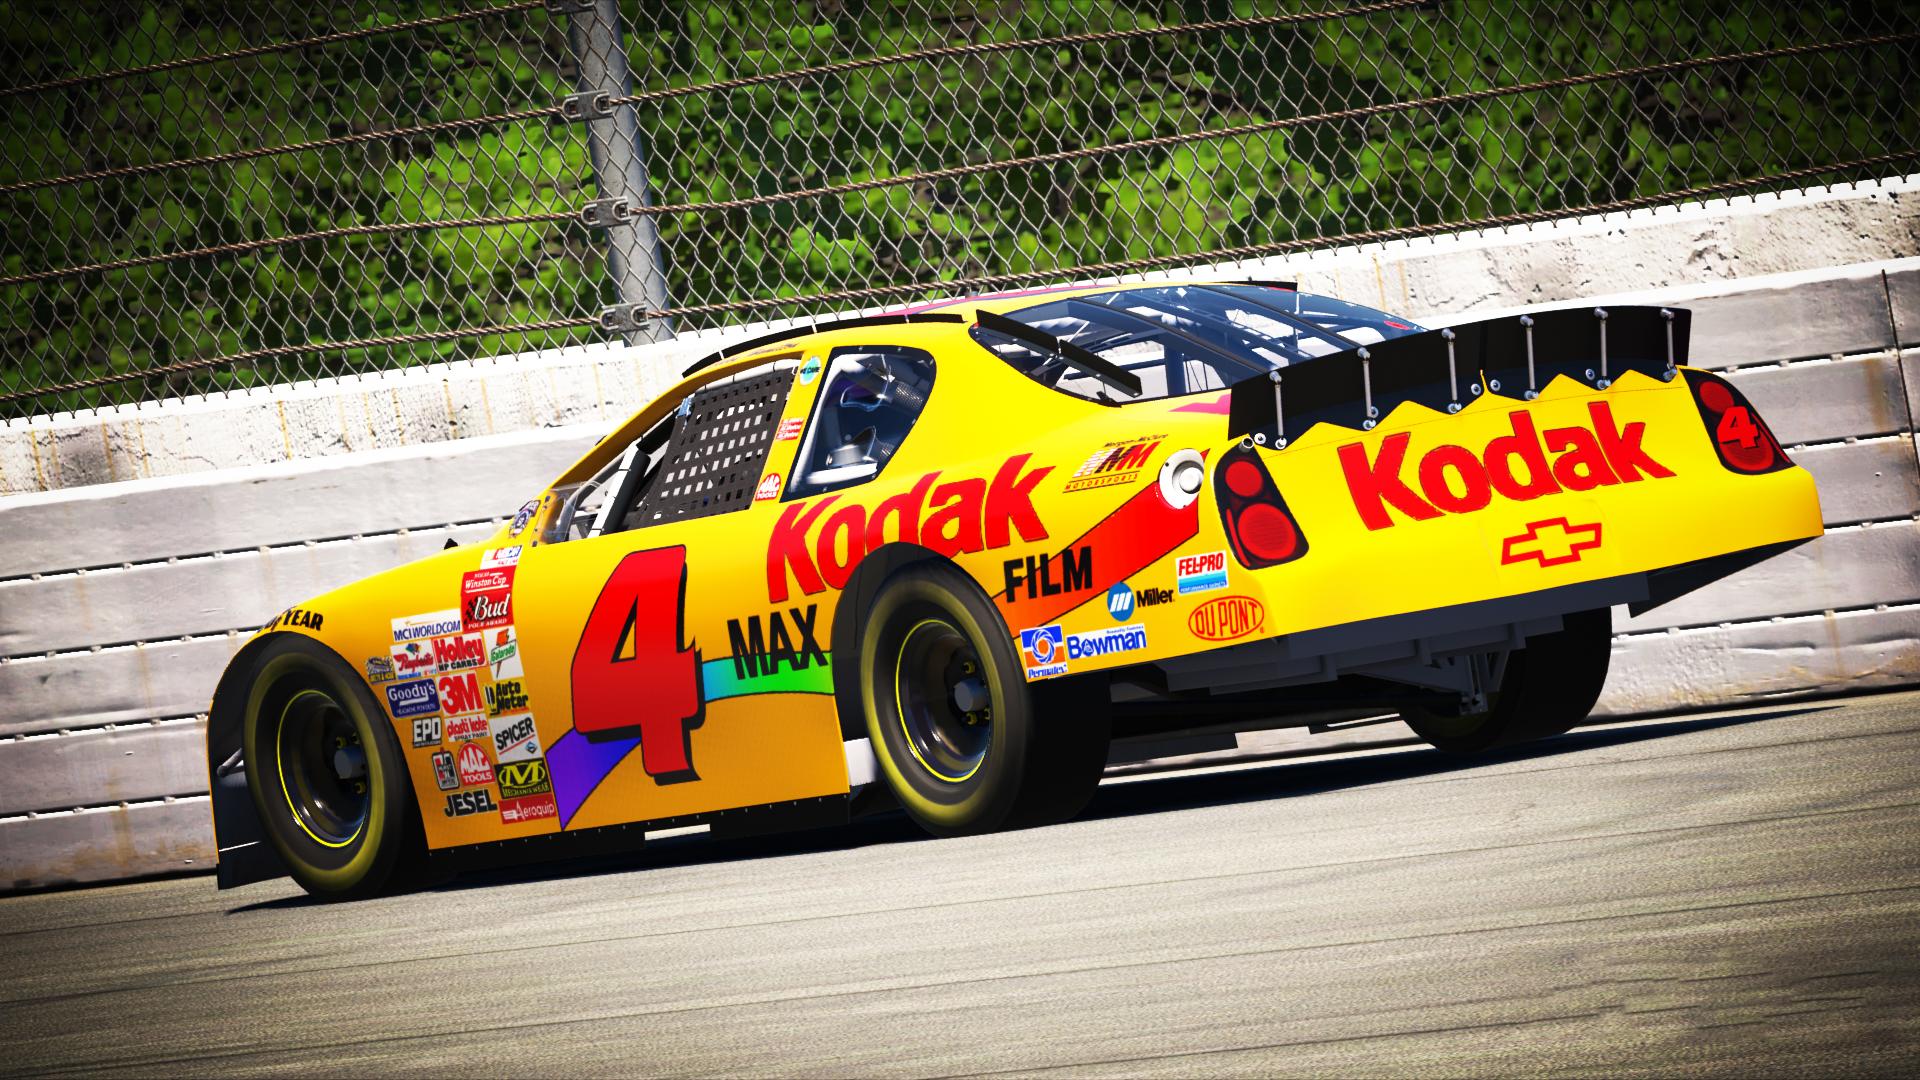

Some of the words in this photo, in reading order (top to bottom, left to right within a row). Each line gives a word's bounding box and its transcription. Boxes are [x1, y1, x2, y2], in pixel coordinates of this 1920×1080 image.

[1716, 406, 1760, 448] 4
[1337, 400, 1677, 531] Kodak
[1065, 473, 1138, 490] MOTORSPORTS
[767, 453, 1056, 603] Kodak
[1003, 546, 1093, 602] FILM
[1179, 552, 1224, 576] FEL-PRO
[492, 575, 507, 587] Cup
[474, 593, 511, 621] Bud
[1136, 588, 1174, 608] Miller
[433, 635, 485, 666] Holley
[727, 604, 830, 681] MAX
[1066, 630, 1147, 660] Bowman
[450, 659, 478, 669] CARBS
[571, 543, 706, 780] 4
[388, 682, 436, 702] Goody's
[438, 673, 484, 715] 3M
[496, 681, 521, 698] Auto
[495, 717, 535, 751] SPICER
[461, 747, 490, 775] MAC
[463, 771, 493, 784] TOOLS
[444, 788, 499, 818] JESEL
[514, 800, 555, 821] Aeroquip
